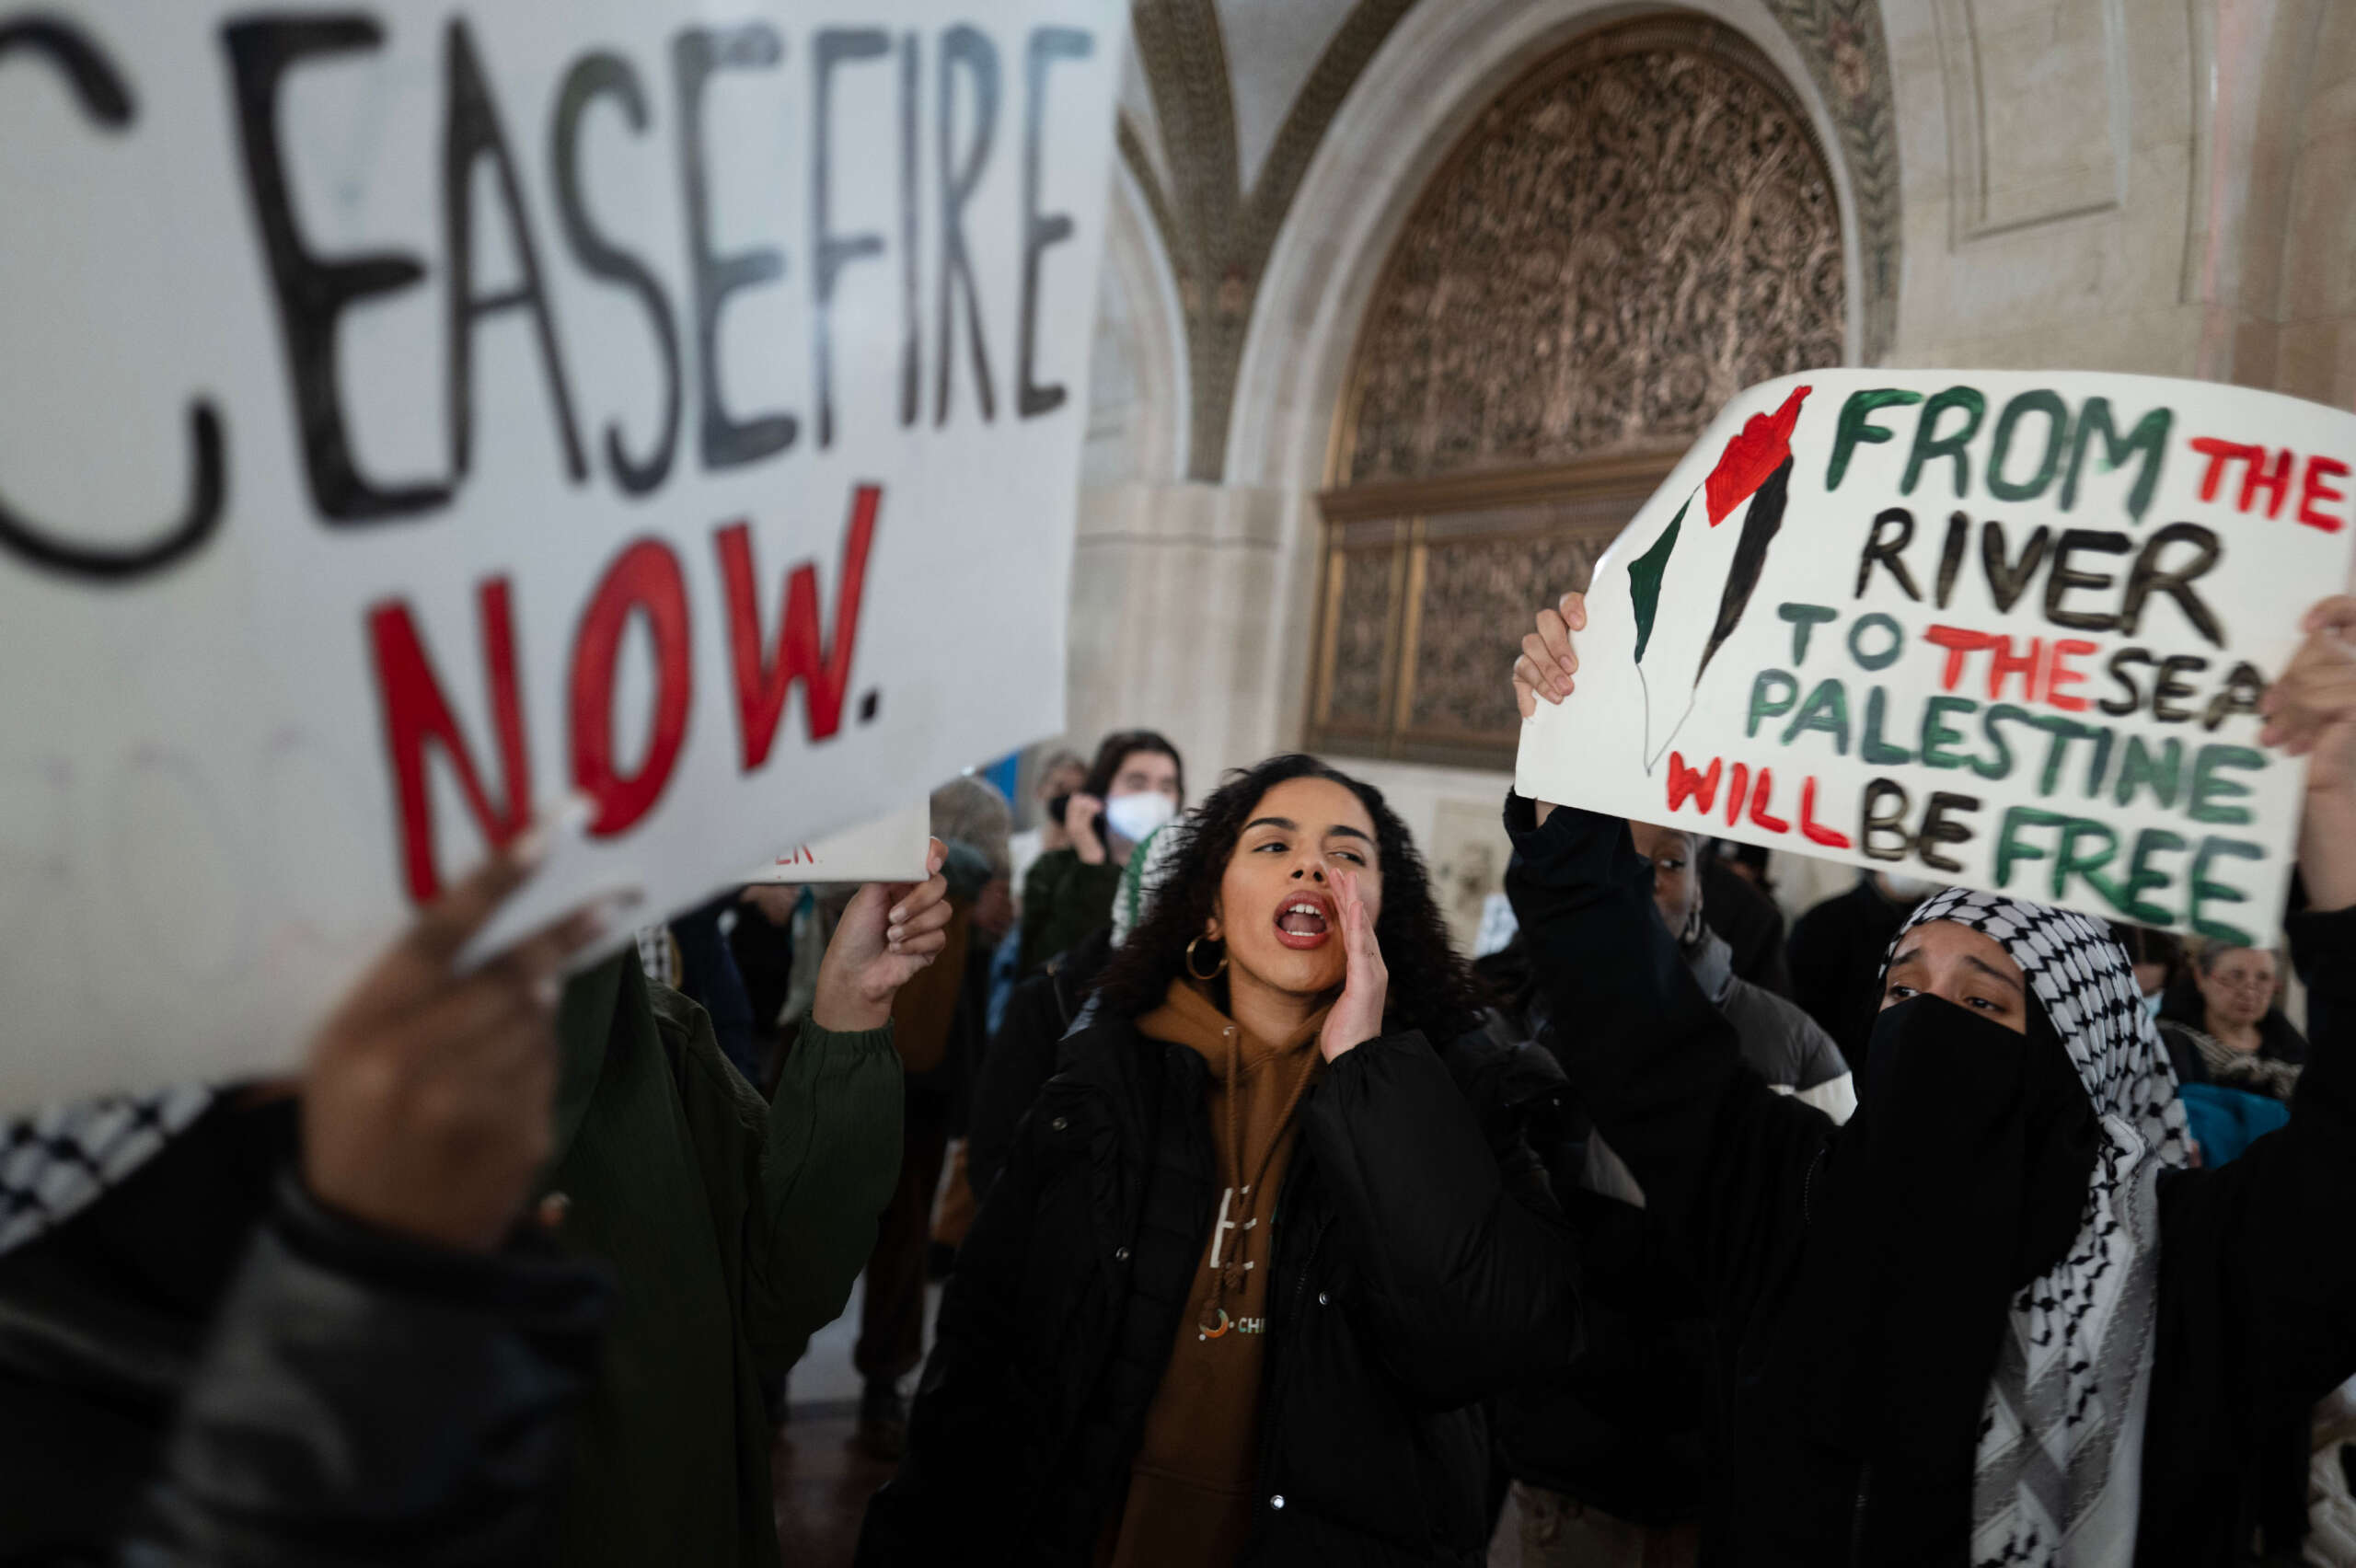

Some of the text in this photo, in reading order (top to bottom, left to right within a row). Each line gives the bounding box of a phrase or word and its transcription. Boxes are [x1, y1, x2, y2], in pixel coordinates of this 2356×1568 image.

[1826, 385, 2353, 534] FROM THE
[1854, 506, 2229, 650] RIVER
[364, 482, 885, 911] NOW.
[1777, 601, 2268, 732] TO THE SEA
[1746, 667, 2269, 825] PALESTINE
[1665, 751, 2265, 950] WILL BE FREE
